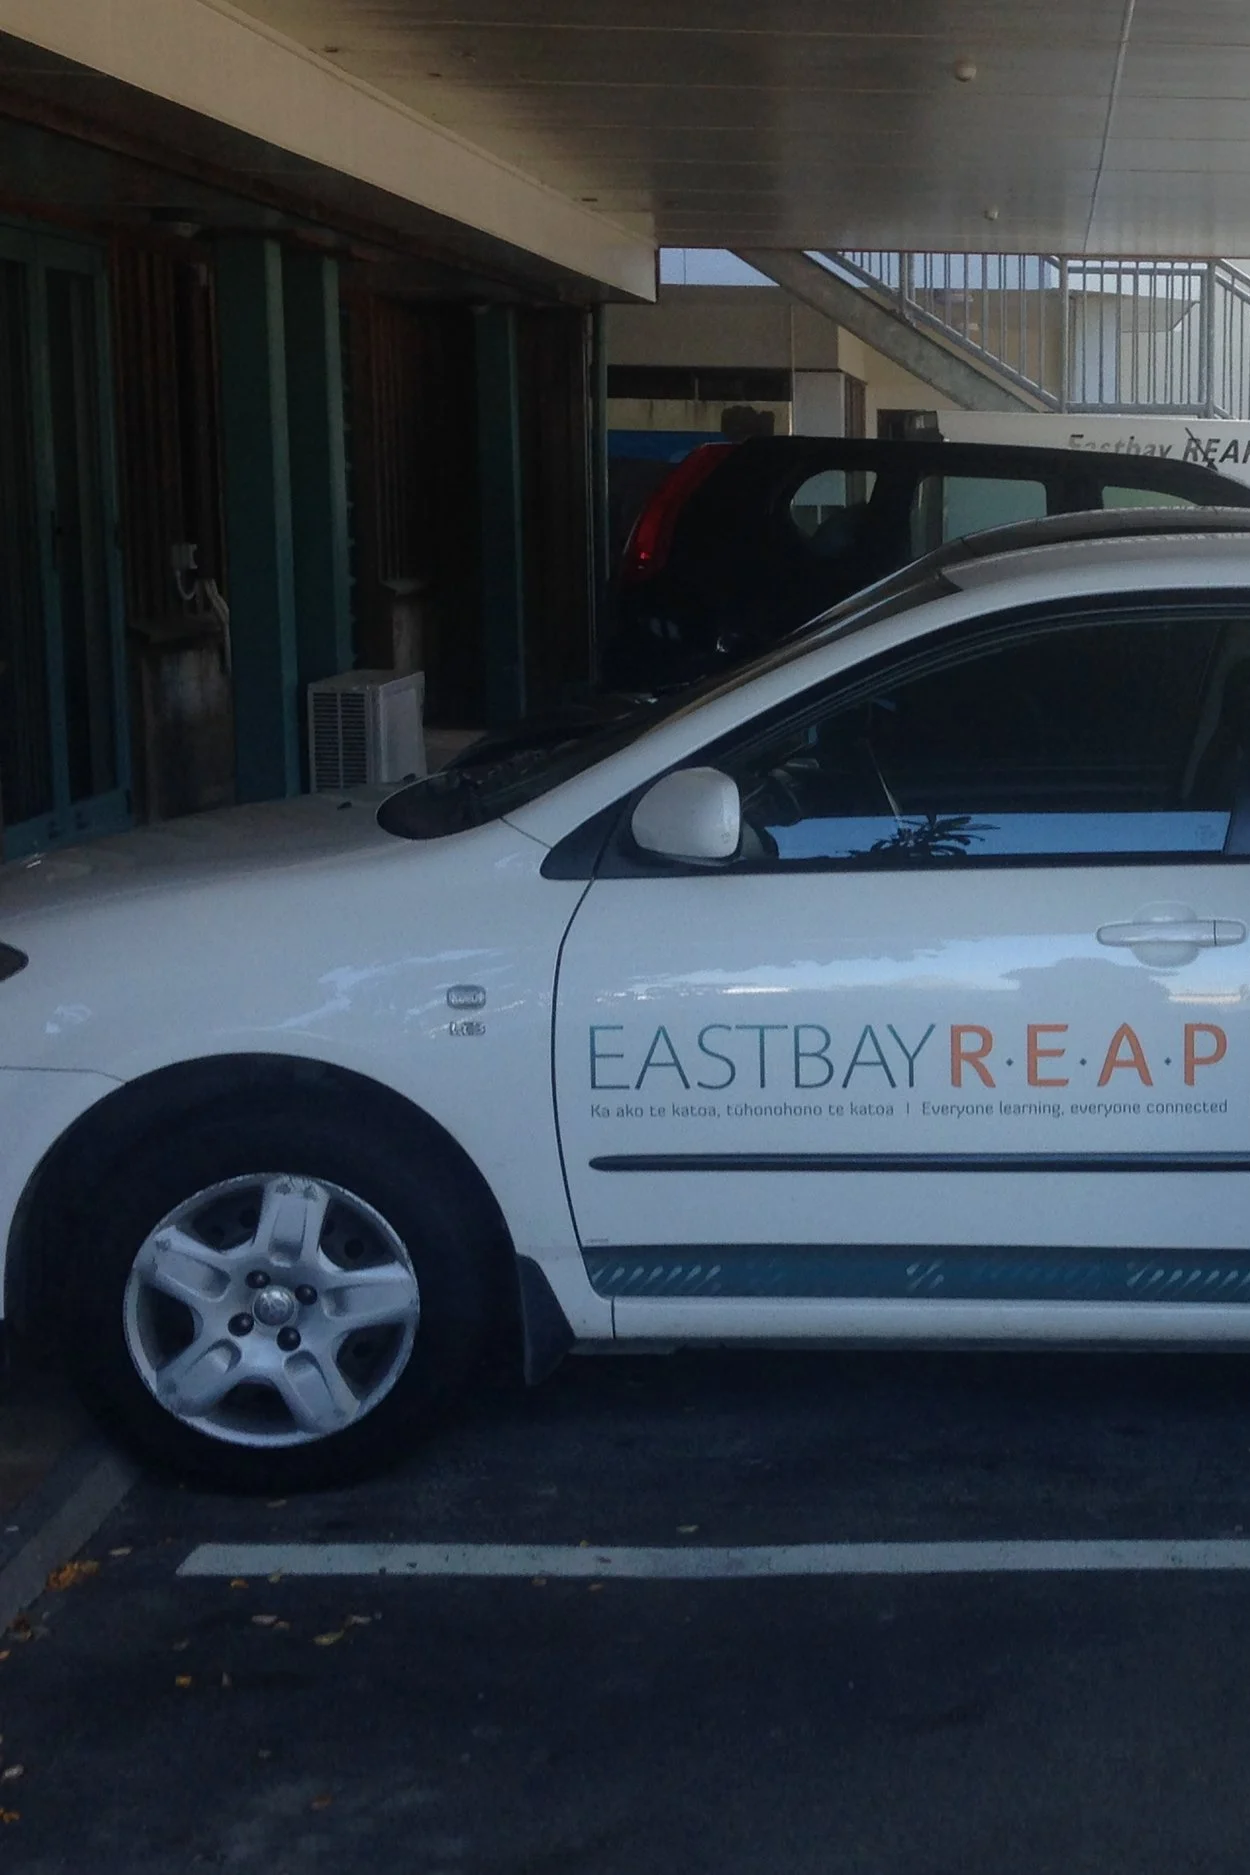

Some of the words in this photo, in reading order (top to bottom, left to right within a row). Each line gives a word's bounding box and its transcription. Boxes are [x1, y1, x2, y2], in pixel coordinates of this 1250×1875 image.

[588, 1023, 936, 1090] EASTBAY
[590, 1103, 611, 1118] Ka
[616, 1103, 644, 1118] ako
[649, 1104, 667, 1118] te
[672, 1103, 721, 1119] katoa,
[828, 1103, 845, 1116] te
[850, 1101, 895, 1116] katoa
[921, 1100, 994, 1119] Everyone
[999, 1100, 1065, 1118] learning,
[1070, 1101, 1142, 1118] everyone
[1146, 1098, 1229, 1115] connected
